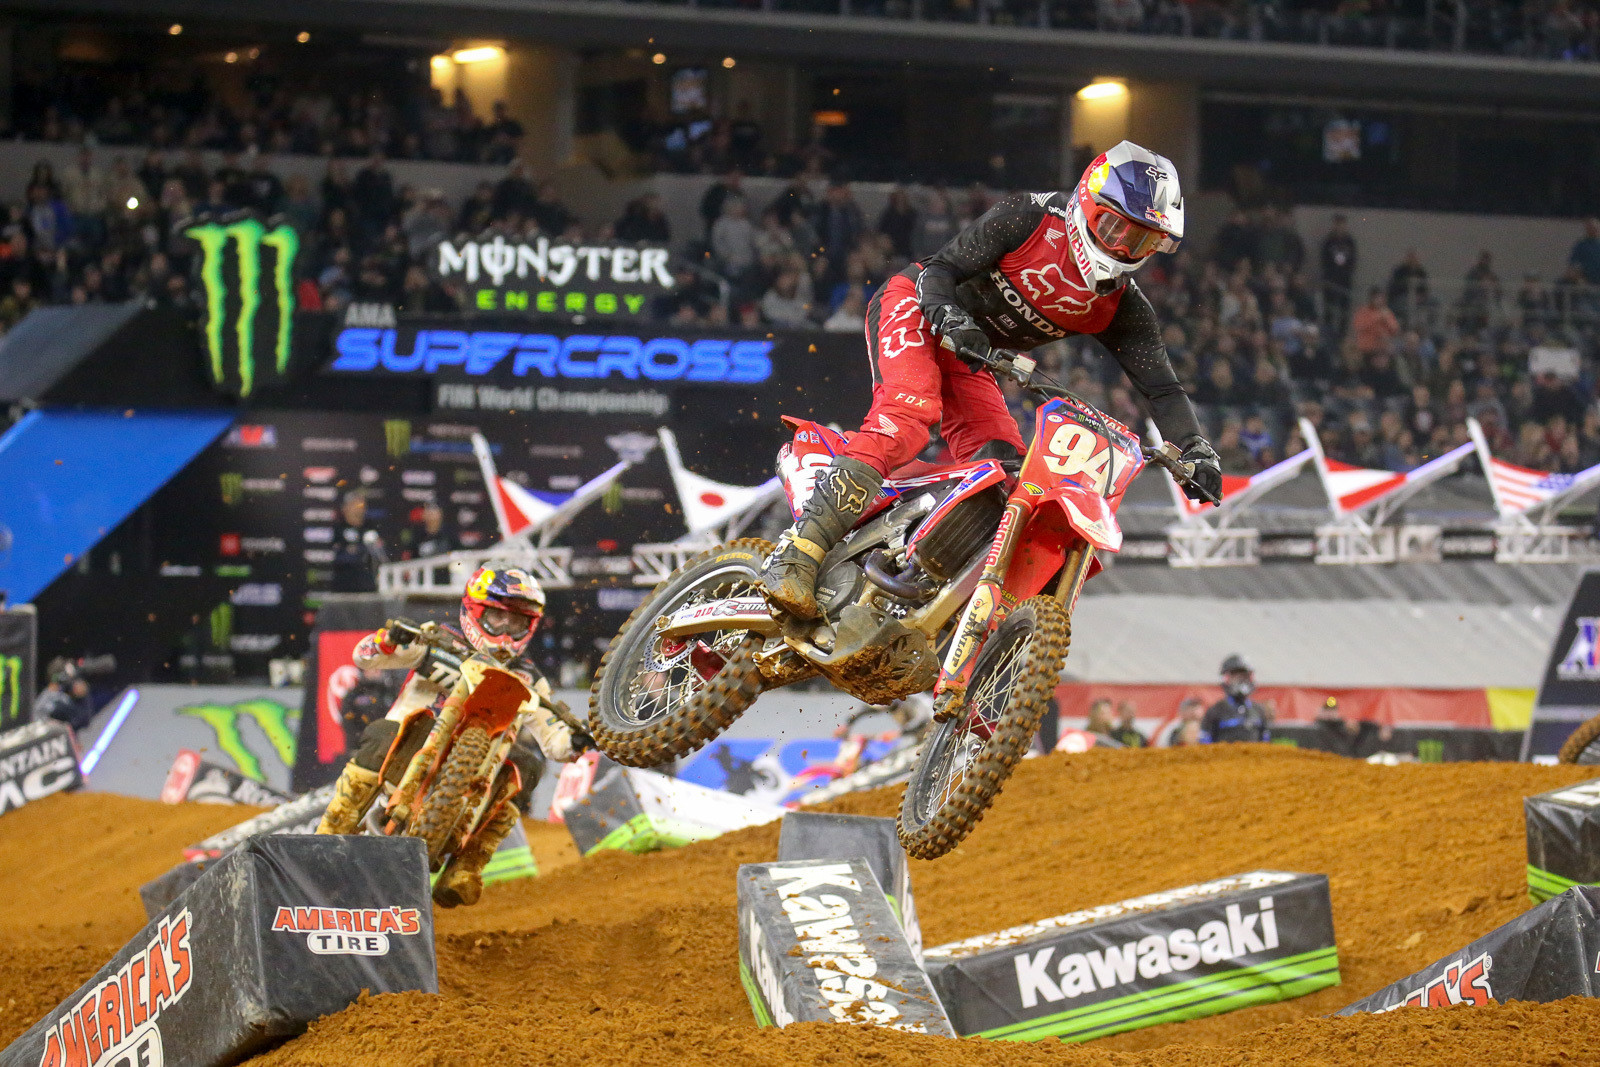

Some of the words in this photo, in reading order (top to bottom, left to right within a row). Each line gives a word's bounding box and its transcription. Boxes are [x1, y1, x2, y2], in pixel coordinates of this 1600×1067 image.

[438, 237, 675, 288] MONSTER
[1071, 235, 1093, 277] Bull
[475, 289, 645, 313] ENERGY
[989, 270, 1066, 338] HONDA
[332, 328, 775, 384] SUPERCROSS
[894, 392, 927, 408] FOX
[869, 426, 896, 439] HONDA
[1043, 423, 1128, 498] 94
[714, 552, 754, 564] DUNLOP
[1001, 589, 1018, 604] SON
[952, 610, 979, 668] DUNLOP
[272, 906, 421, 935] AMERICA'S
[316, 934, 380, 951] TIRE
[769, 863, 928, 1034] Kawasa
[1014, 896, 1279, 1008] Kawasaki
[41, 906, 194, 1067] AMERICA'S
